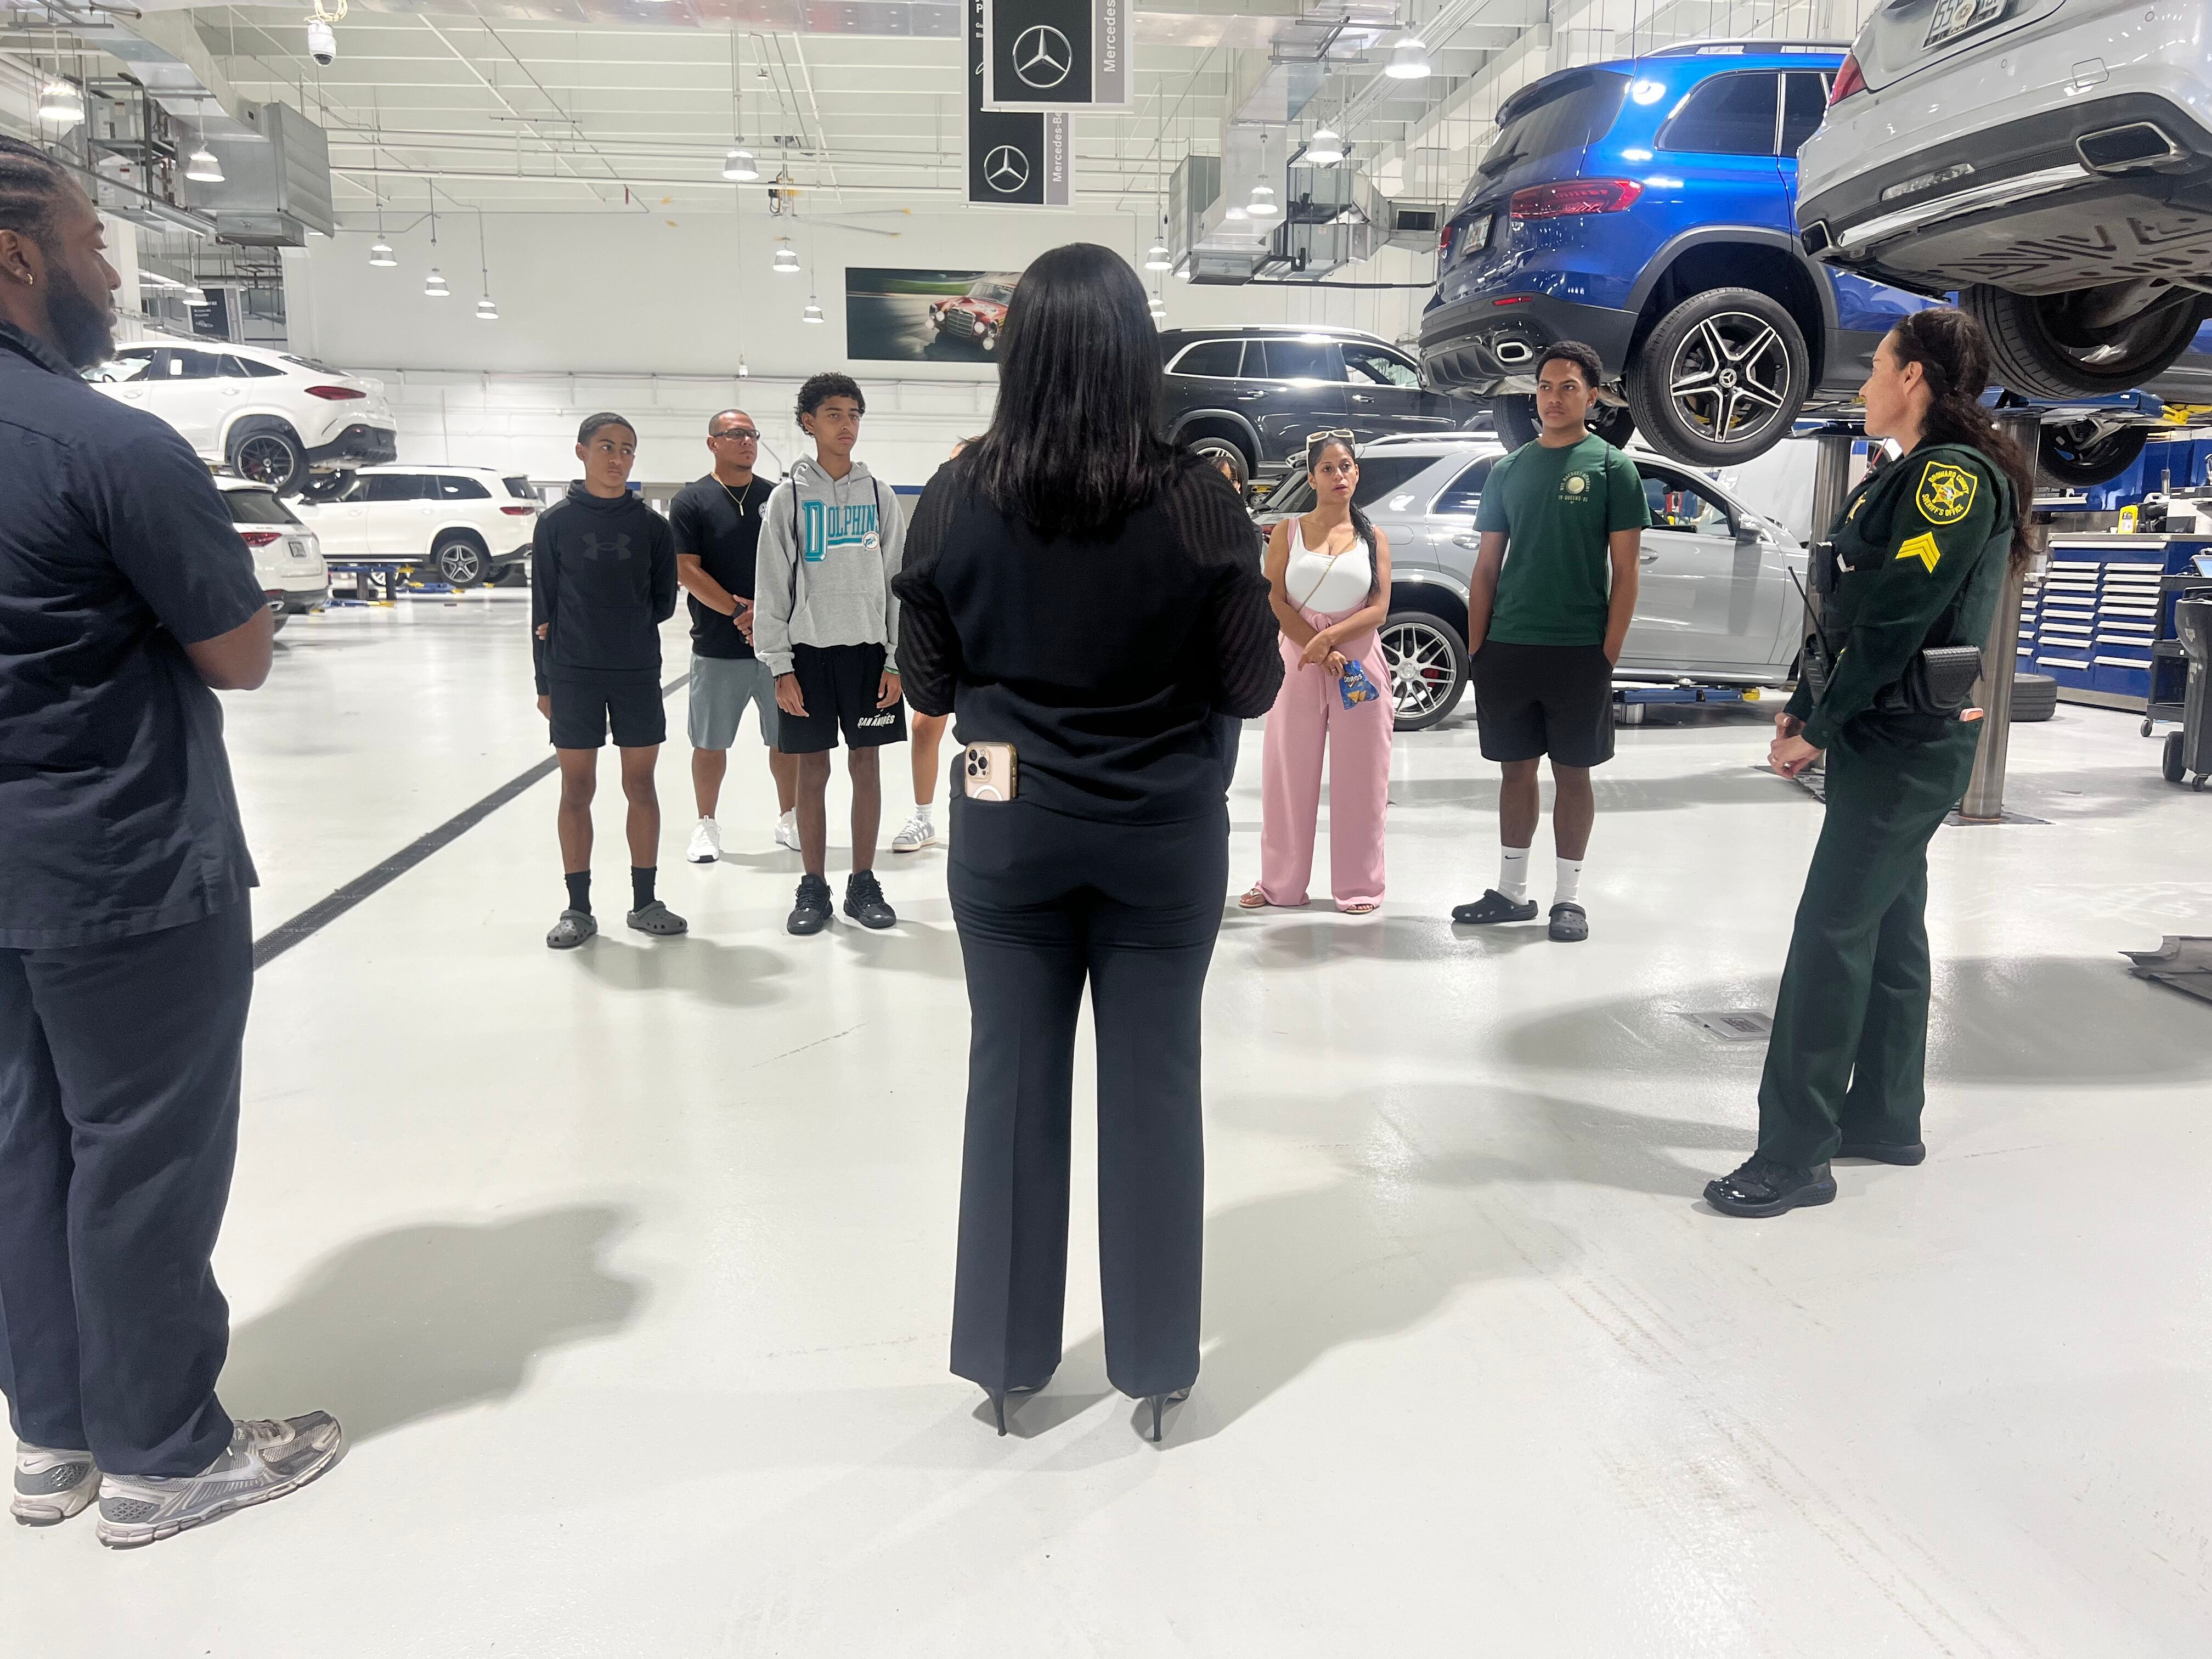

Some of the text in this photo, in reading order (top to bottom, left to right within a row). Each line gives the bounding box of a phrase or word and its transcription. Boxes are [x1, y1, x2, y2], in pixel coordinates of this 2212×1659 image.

[1927, 470, 1970, 494] BROWARD COUNTY
[1922, 493, 1964, 517] SHERIFF'S OFFICE
